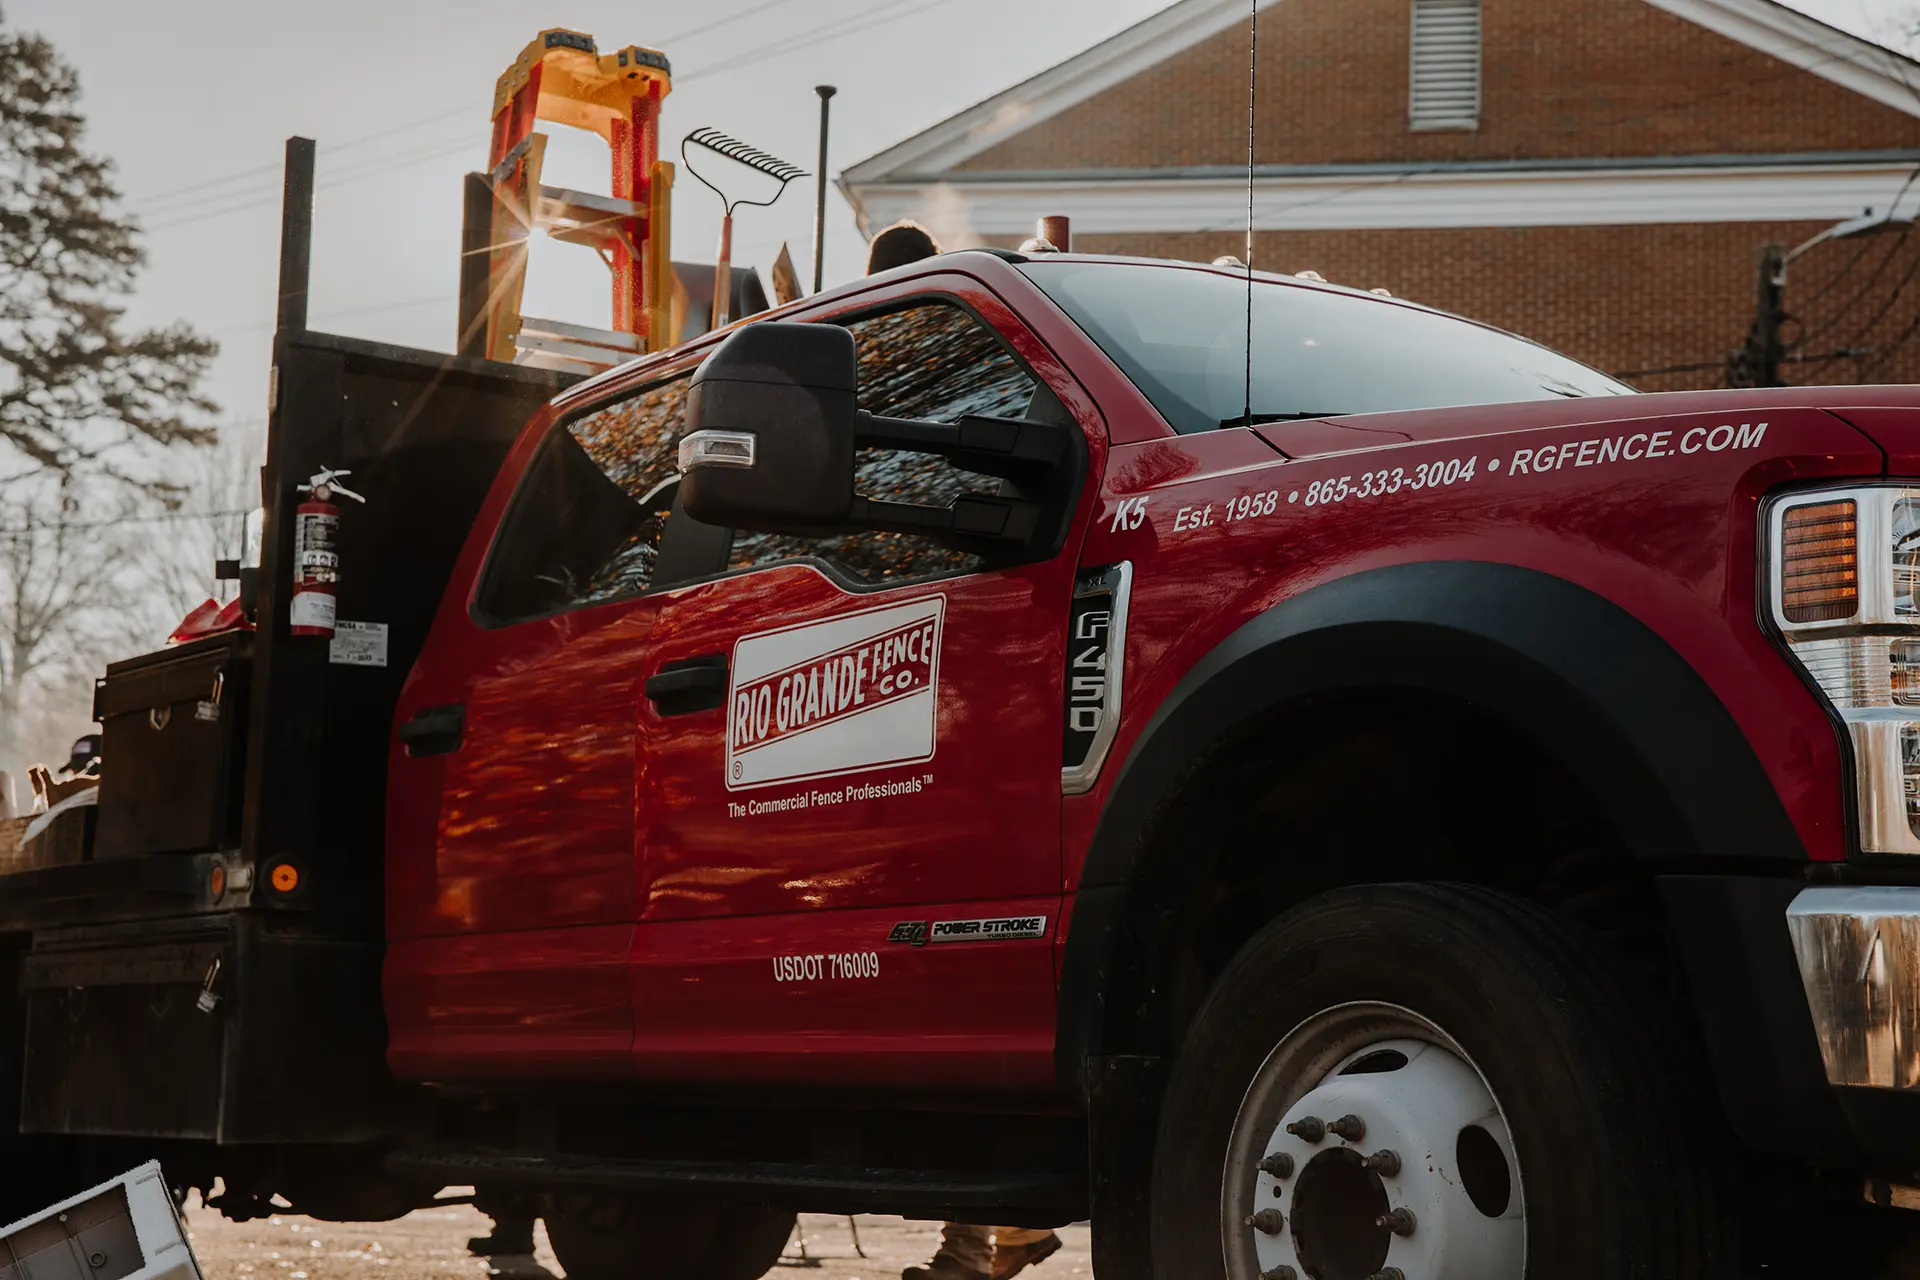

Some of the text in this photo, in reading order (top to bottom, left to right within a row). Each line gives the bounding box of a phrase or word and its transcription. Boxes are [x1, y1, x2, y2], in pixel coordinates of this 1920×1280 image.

[1173, 422, 1768, 533] Est. 1958 865-333-3004 RGFENCE.COM
[1111, 495, 1150, 533] K5
[1088, 575, 1107, 588] XL
[734, 624, 933, 748] RIO GRANDE FENCE
[879, 670, 919, 696] CO.
[1069, 610, 1110, 732] F450
[728, 802, 746, 818] The
[748, 792, 809, 815] Commercial
[811, 790, 843, 807] Fence
[983, 917, 1041, 932] STROKE
[772, 951, 880, 982] USDOT 716009
